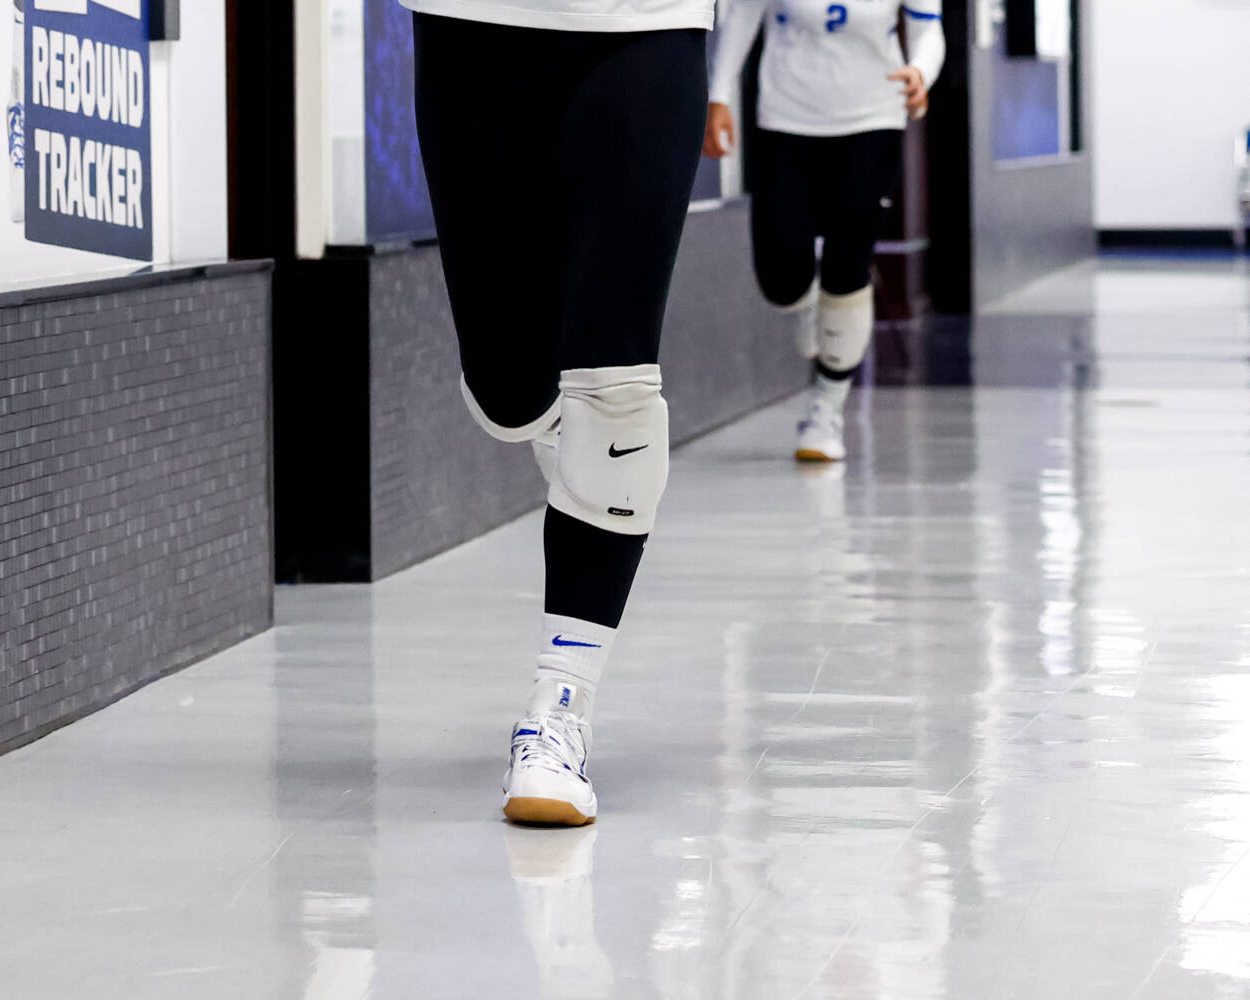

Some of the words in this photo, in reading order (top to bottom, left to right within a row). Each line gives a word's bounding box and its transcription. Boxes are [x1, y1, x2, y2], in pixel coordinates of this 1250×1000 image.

[825, 4, 848, 33] 2
[32, 26, 144, 128] REBOUND
[34, 128, 144, 230] TRACKER
